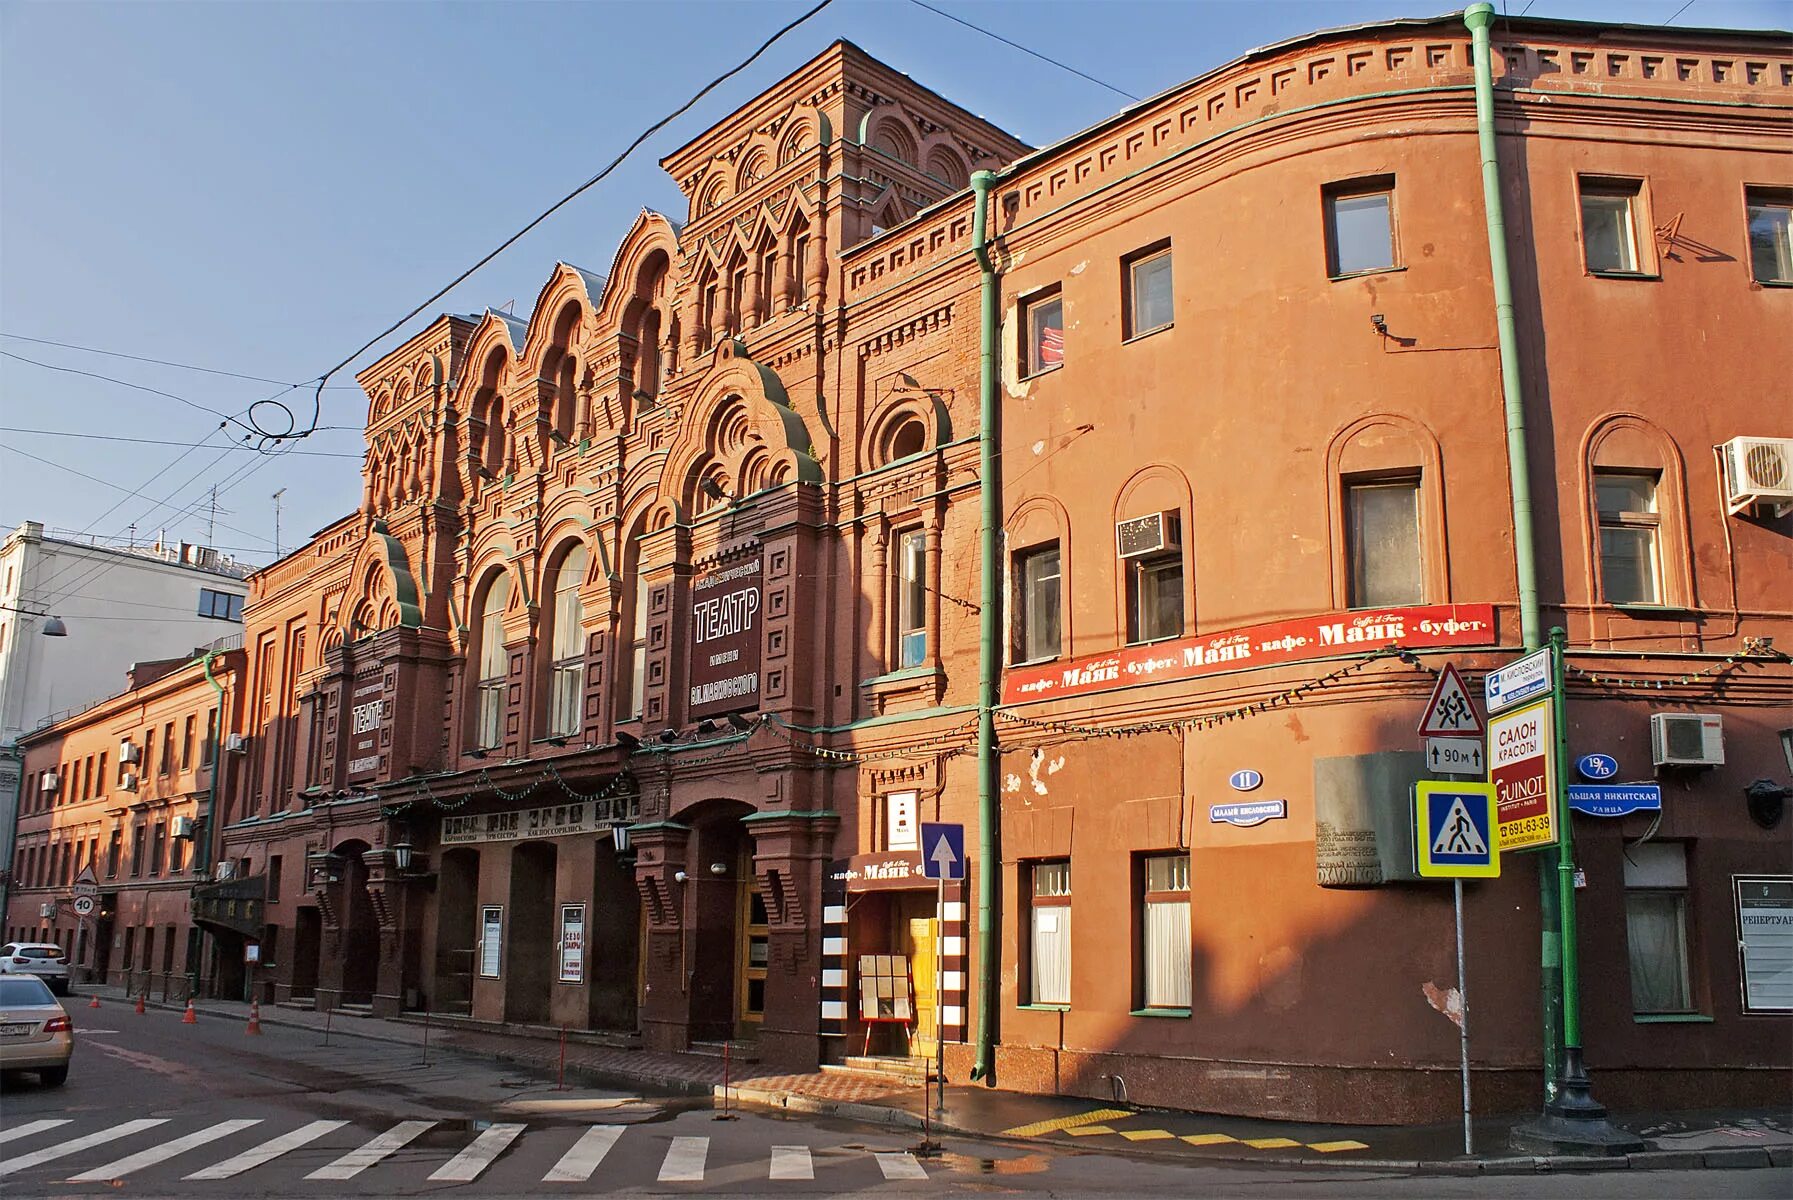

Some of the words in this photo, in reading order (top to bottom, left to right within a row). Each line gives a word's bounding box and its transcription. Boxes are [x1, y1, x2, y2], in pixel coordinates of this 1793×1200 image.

[694, 587, 759, 643] ТЕАТР
[1383, 614, 1404, 622] Faro
[709, 650, 739, 666] ИМЕНИ
[1021, 678, 1054, 693] кафе
[1060, 665, 1119, 688] Маяк
[1127, 658, 1173, 675] буфет
[1183, 643, 1251, 668] Маяк
[1261, 635, 1307, 652] кафе
[1317, 623, 1406, 647] Маяк
[1420, 619, 1482, 636] буфет
[1499, 720, 1537, 747] САЛОН
[1444, 749, 1459, 762] 90
[1498, 739, 1537, 762] КРАСОТЫ
[1588, 757, 1610, 775] 19/13
[1239, 772, 1251, 788] 11
[1496, 775, 1544, 803] GUINOT
[1213, 807, 1239, 817] МАЛЫЙ
[1240, 804, 1280, 815] КИСЛОВСКИЙ
[1509, 816, 1550, 837] 691-63-39
[834, 870, 858, 881] кафе
[864, 865, 909, 880] Маяк
[77, 900, 90, 910] 40
[565, 932, 580, 941] СЕЗО
[565, 941, 580, 950] ЗАКРЫ
